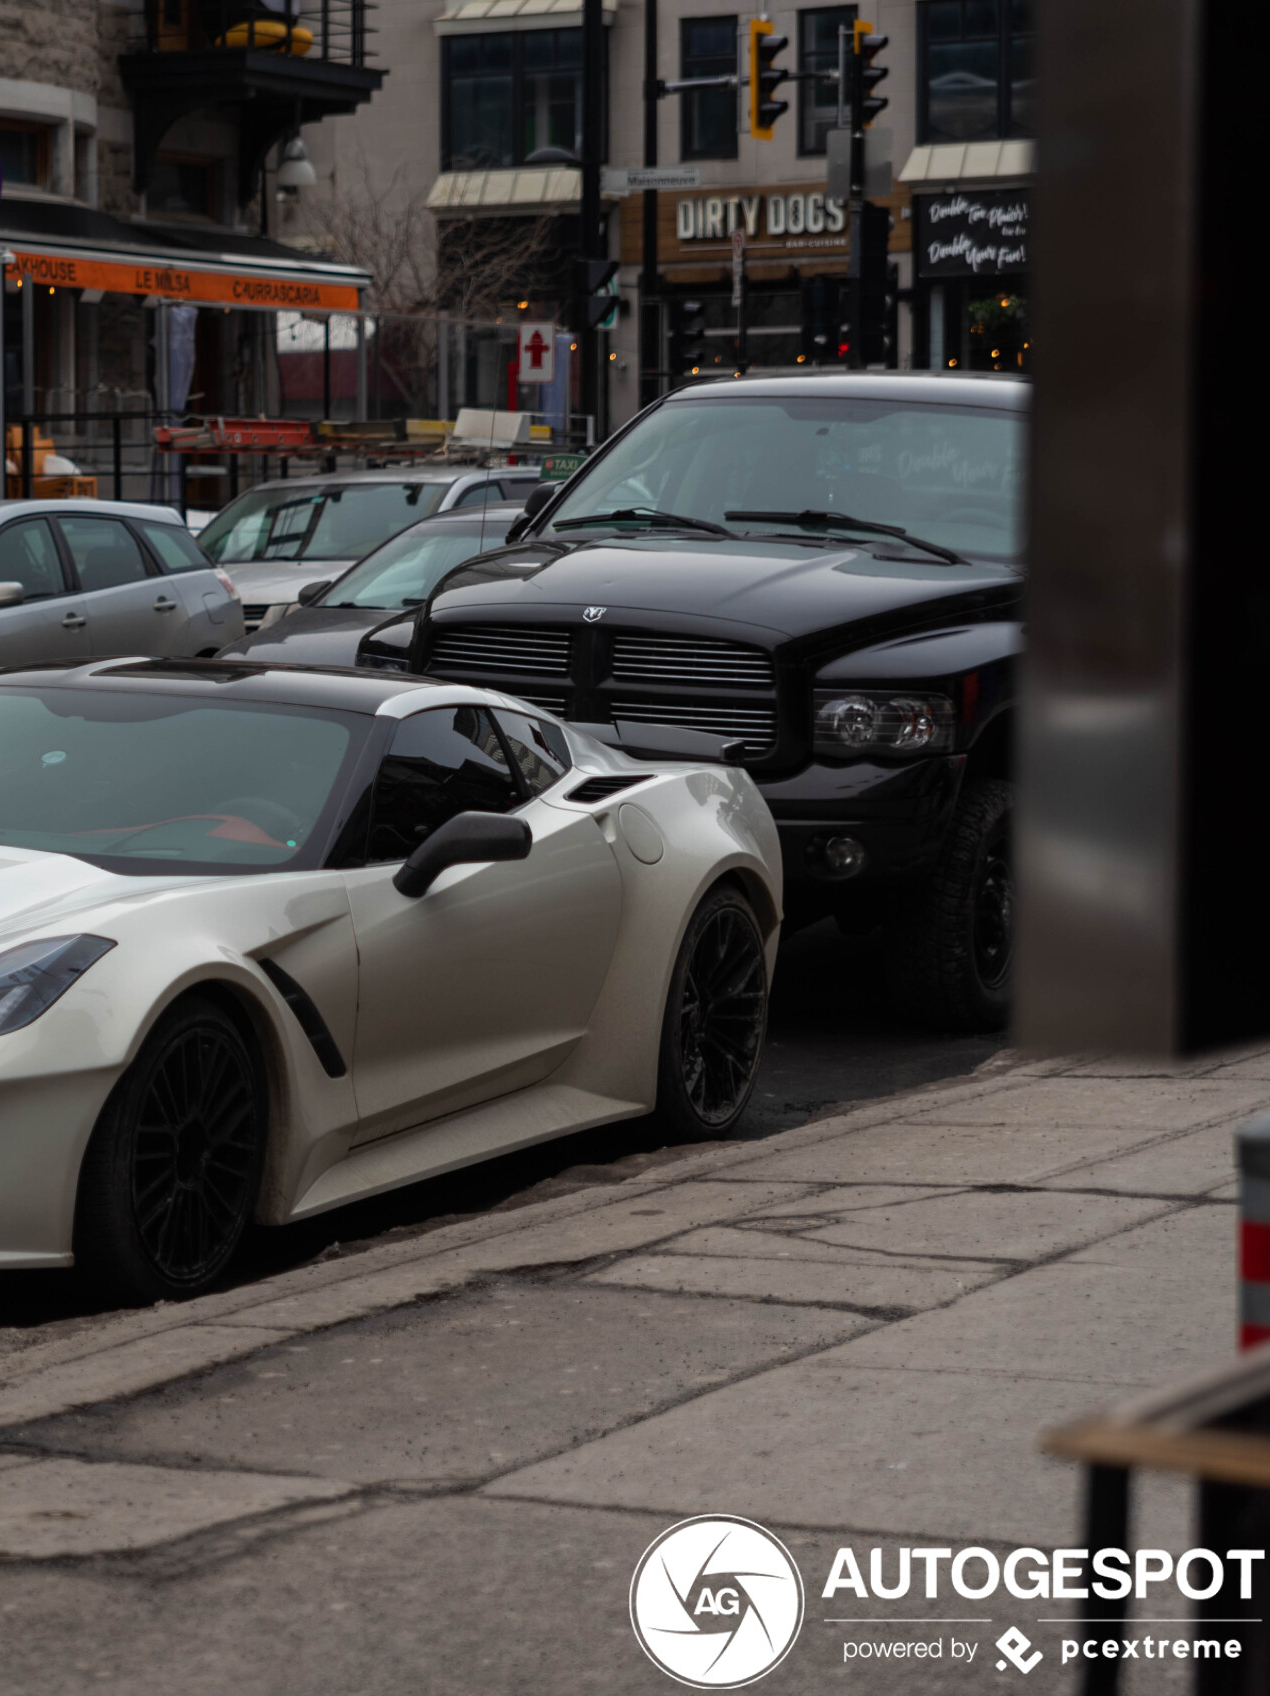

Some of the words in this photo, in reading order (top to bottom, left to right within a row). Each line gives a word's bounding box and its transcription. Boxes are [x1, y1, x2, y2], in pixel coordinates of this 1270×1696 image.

[676, 196, 760, 240] DIRTY
[767, 190, 847, 236] DOGS
[927, 232, 972, 264] Double
[965, 245, 997, 273] Your
[135, 269, 152, 289] LE
[555, 459, 579, 470] TAXI
